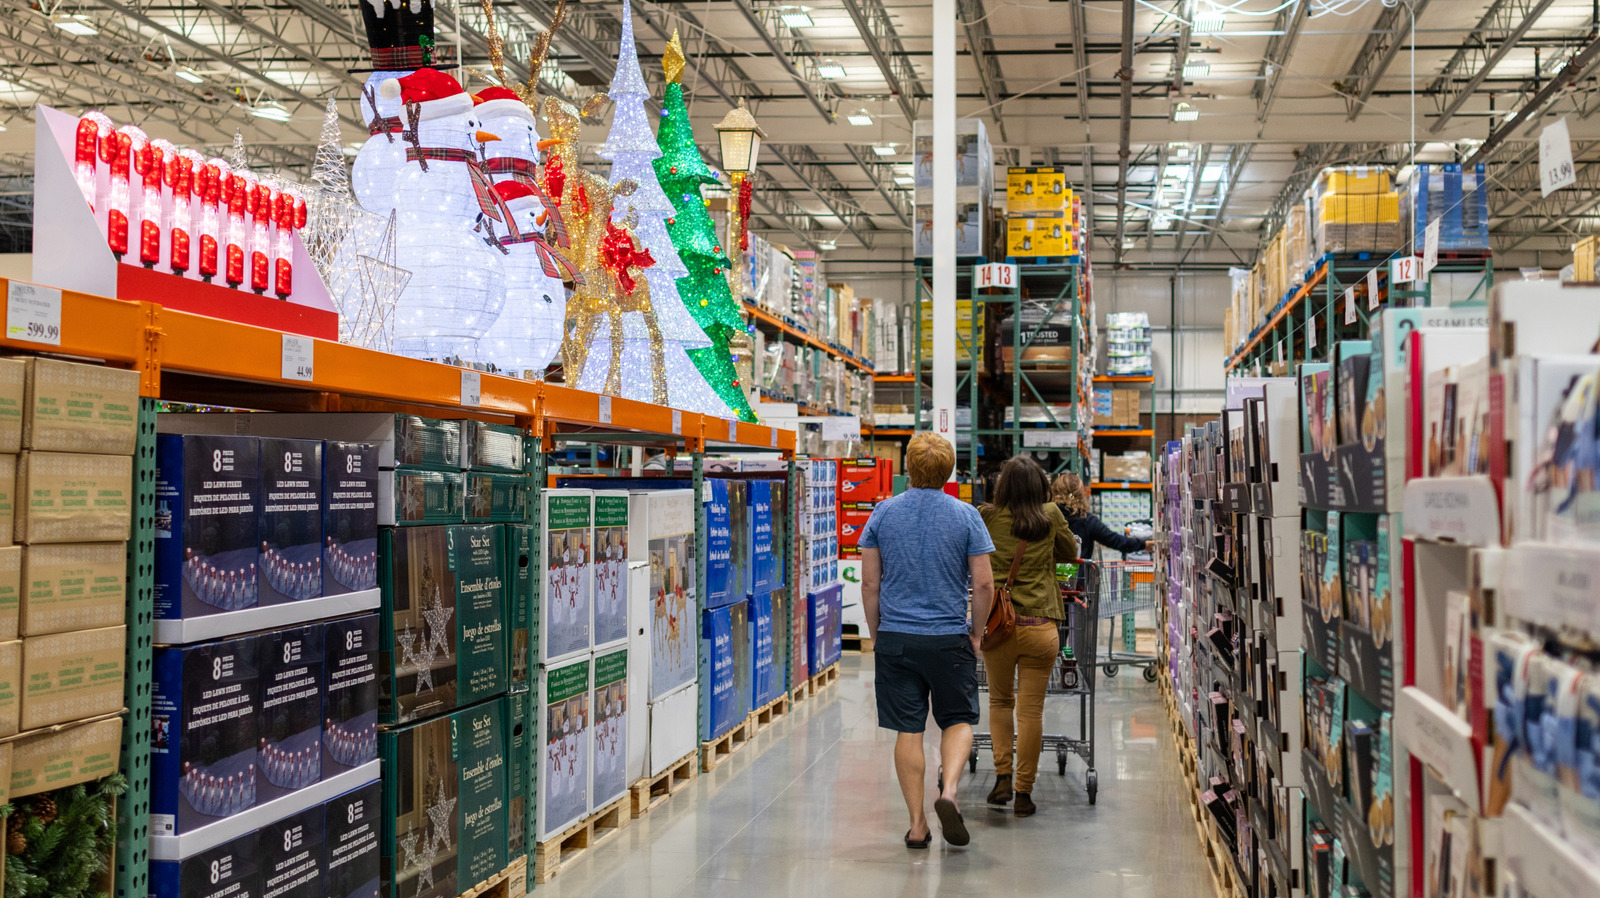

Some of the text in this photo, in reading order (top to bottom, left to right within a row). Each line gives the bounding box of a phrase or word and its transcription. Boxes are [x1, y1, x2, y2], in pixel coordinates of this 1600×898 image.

[1549, 162, 1572, 186] 13.99
[982, 266, 991, 285] 14
[998, 266, 1011, 285] 13
[1399, 260, 1411, 280] 12
[1416, 260, 1424, 280] 11
[27, 322, 59, 340] 599.99
[297, 366, 312, 377] 44.99
[213, 449, 222, 472] 8
[284, 452, 292, 472] 8
[346, 454, 353, 473] 8
[203, 480, 242, 489] LED LAWN STAKES
[448, 530, 454, 550] 3
[470, 535, 490, 548] Star Set
[461, 578, 483, 594] Ensemble
[346, 631, 353, 650] 8
[462, 619, 502, 642] Juego de estrellas
[284, 642, 290, 664] 8
[213, 657, 221, 680] 8
[283, 670, 295, 679] LAWN
[295, 667, 308, 676] STAKES
[203, 684, 242, 699] LED LAWN STAKES
[193, 704, 212, 715] PIQUETS
[219, 697, 238, 708] PELOUSE
[228, 710, 238, 719] PARA
[452, 719, 457, 740] 3
[472, 714, 491, 731] Star Set
[463, 761, 484, 781] Ensemble
[348, 803, 354, 824] 8
[464, 812, 477, 830] Juego
[478, 805, 484, 818] de
[484, 797, 502, 815] estrellas
[284, 830, 291, 851] 8
[276, 850, 310, 871] LED LAWN STAKES
[211, 860, 219, 884] 8
[224, 882, 240, 895] STAKES
